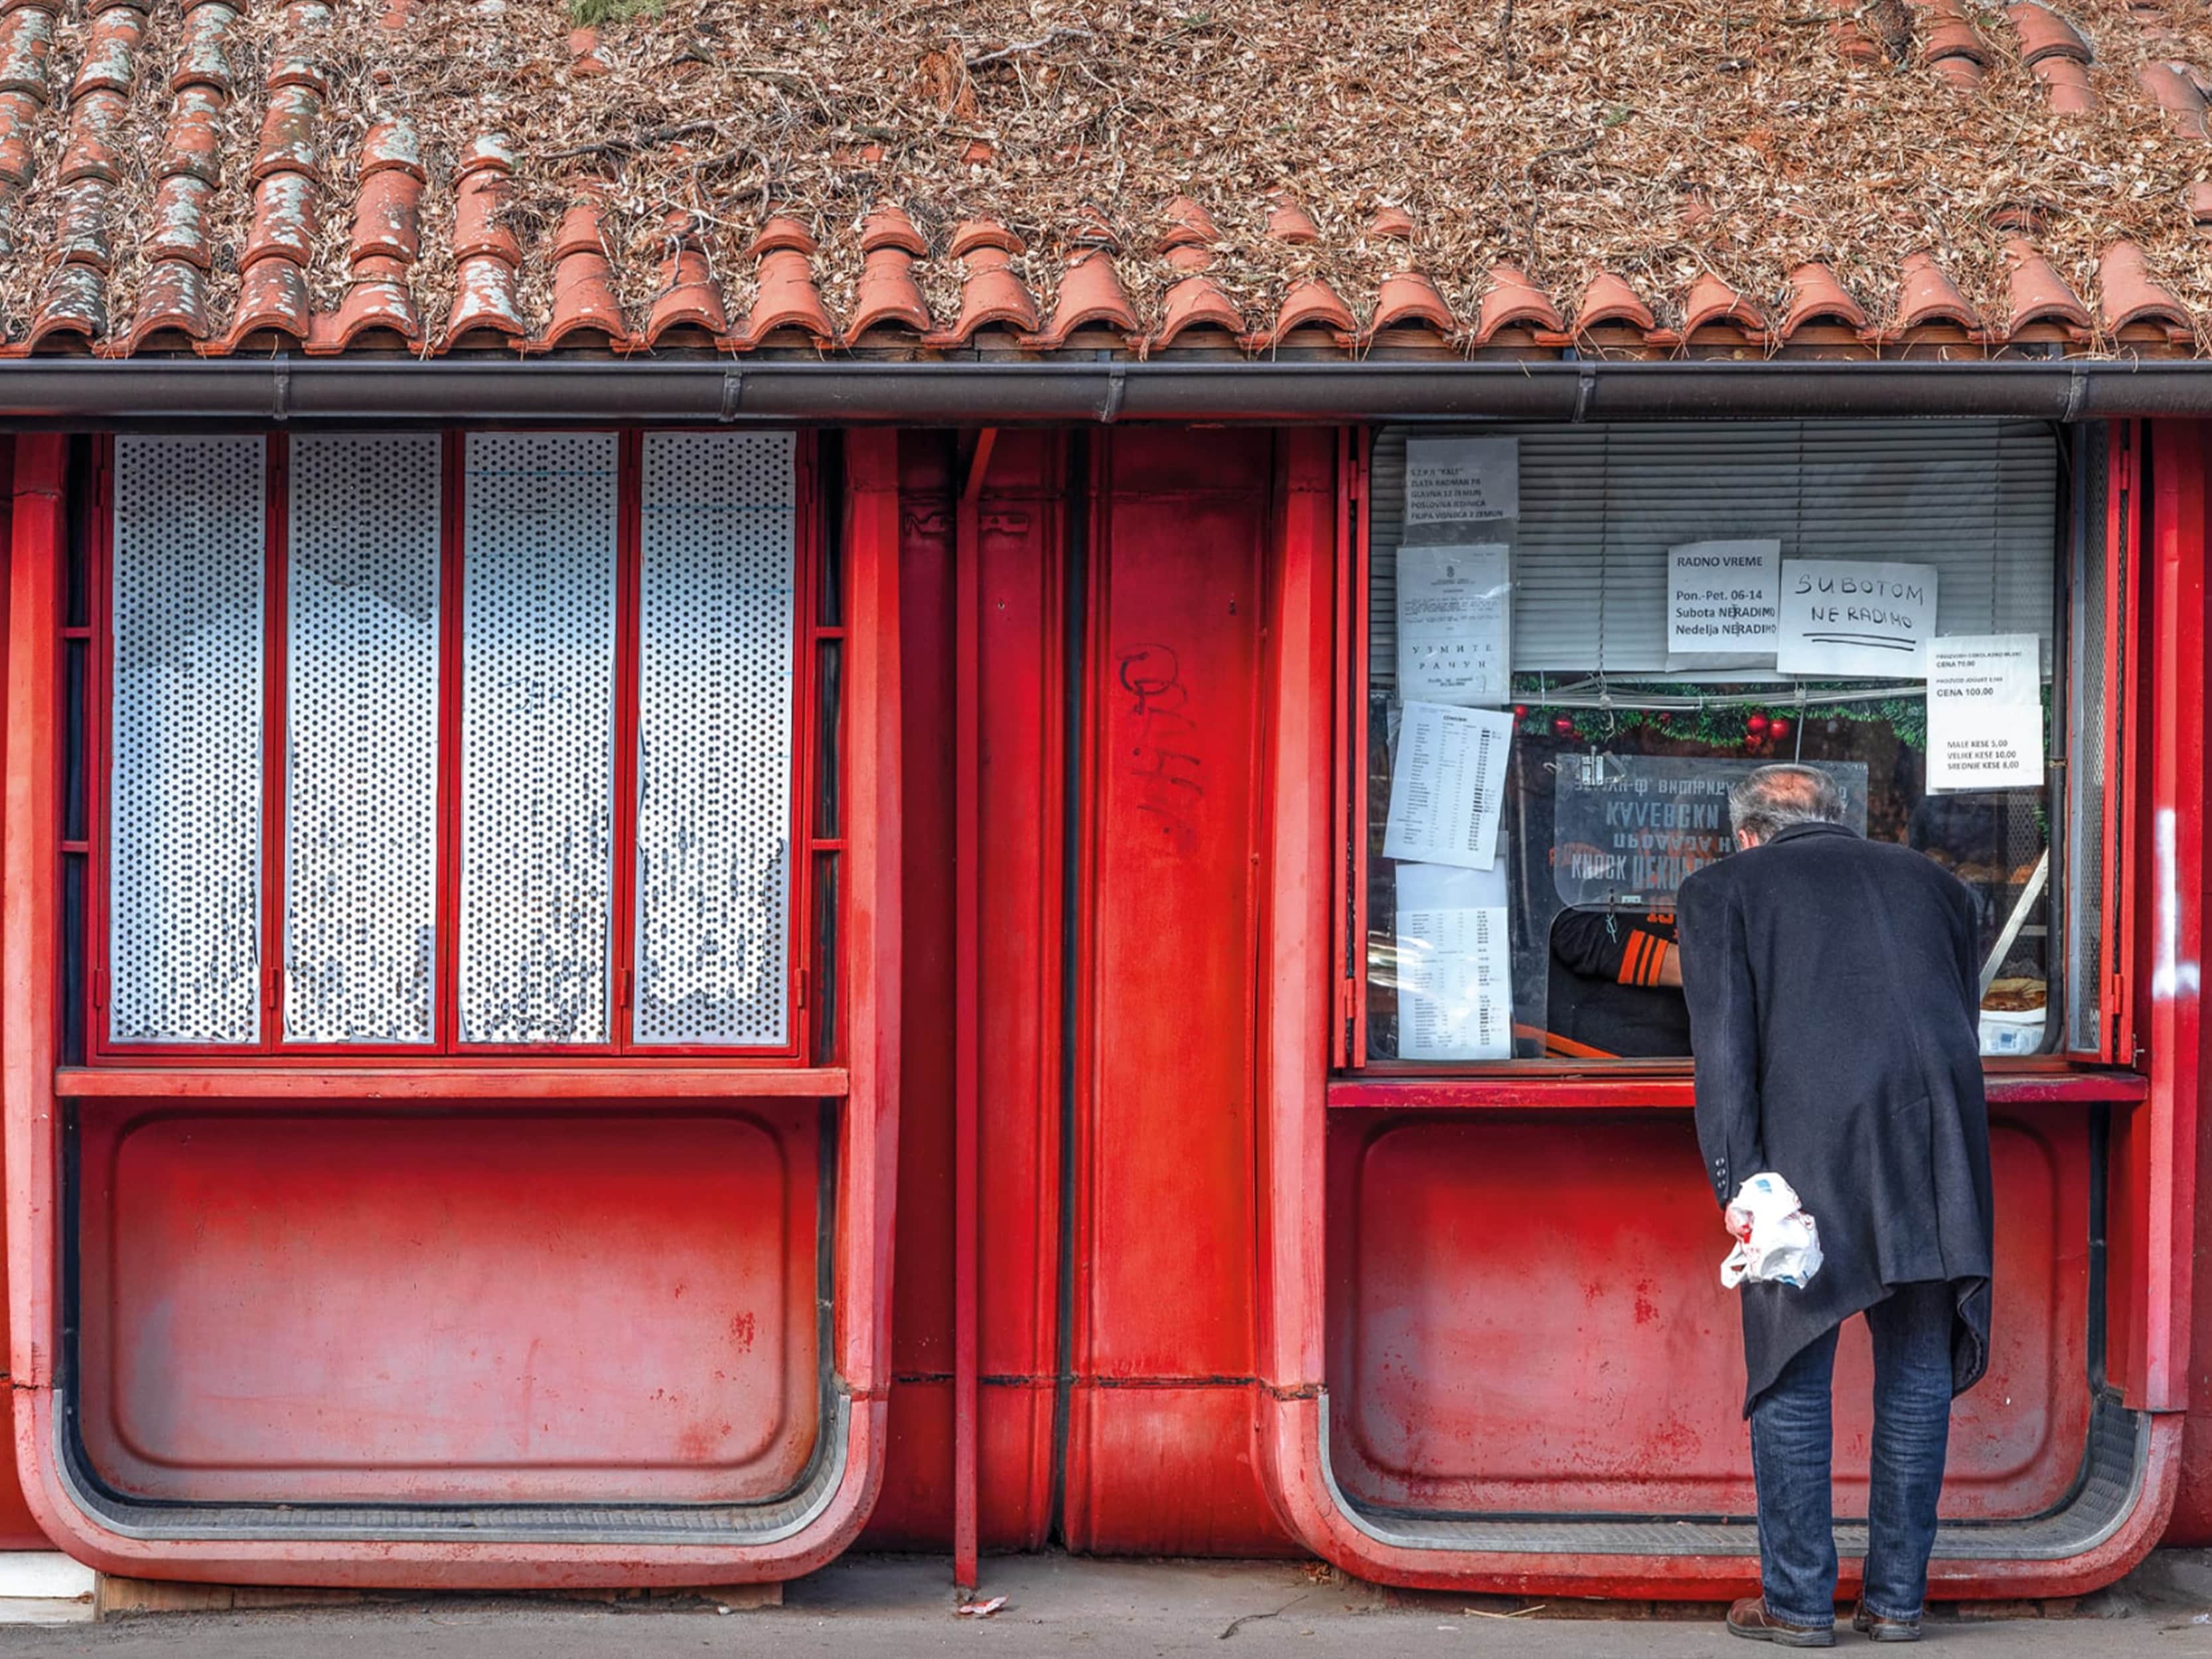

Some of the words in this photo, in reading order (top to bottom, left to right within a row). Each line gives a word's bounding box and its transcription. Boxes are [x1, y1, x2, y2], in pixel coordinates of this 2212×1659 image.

[1475, 509, 1503, 518] ZEMUN
[1677, 556, 1720, 567] RADNO
[1722, 556, 1763, 566] VREME
[1795, 573, 1923, 606] SUBOTOM
[1676, 590, 1728, 601] Pon.-Pet.
[1730, 589, 1763, 600] 06-14
[1676, 607, 1716, 618] Subota
[1811, 605, 1840, 622] NE
[1847, 606, 1913, 628] RADIMO
[1676, 624, 1719, 636] Nedelja
[1937, 660, 1956, 669] CENA
[1937, 688, 1963, 697] CENA
[1947, 740, 1968, 749] MALE
[1947, 751, 1972, 760] VELIKE
[1974, 751, 1993, 759] KESE
[1982, 761, 2000, 770] KESE
